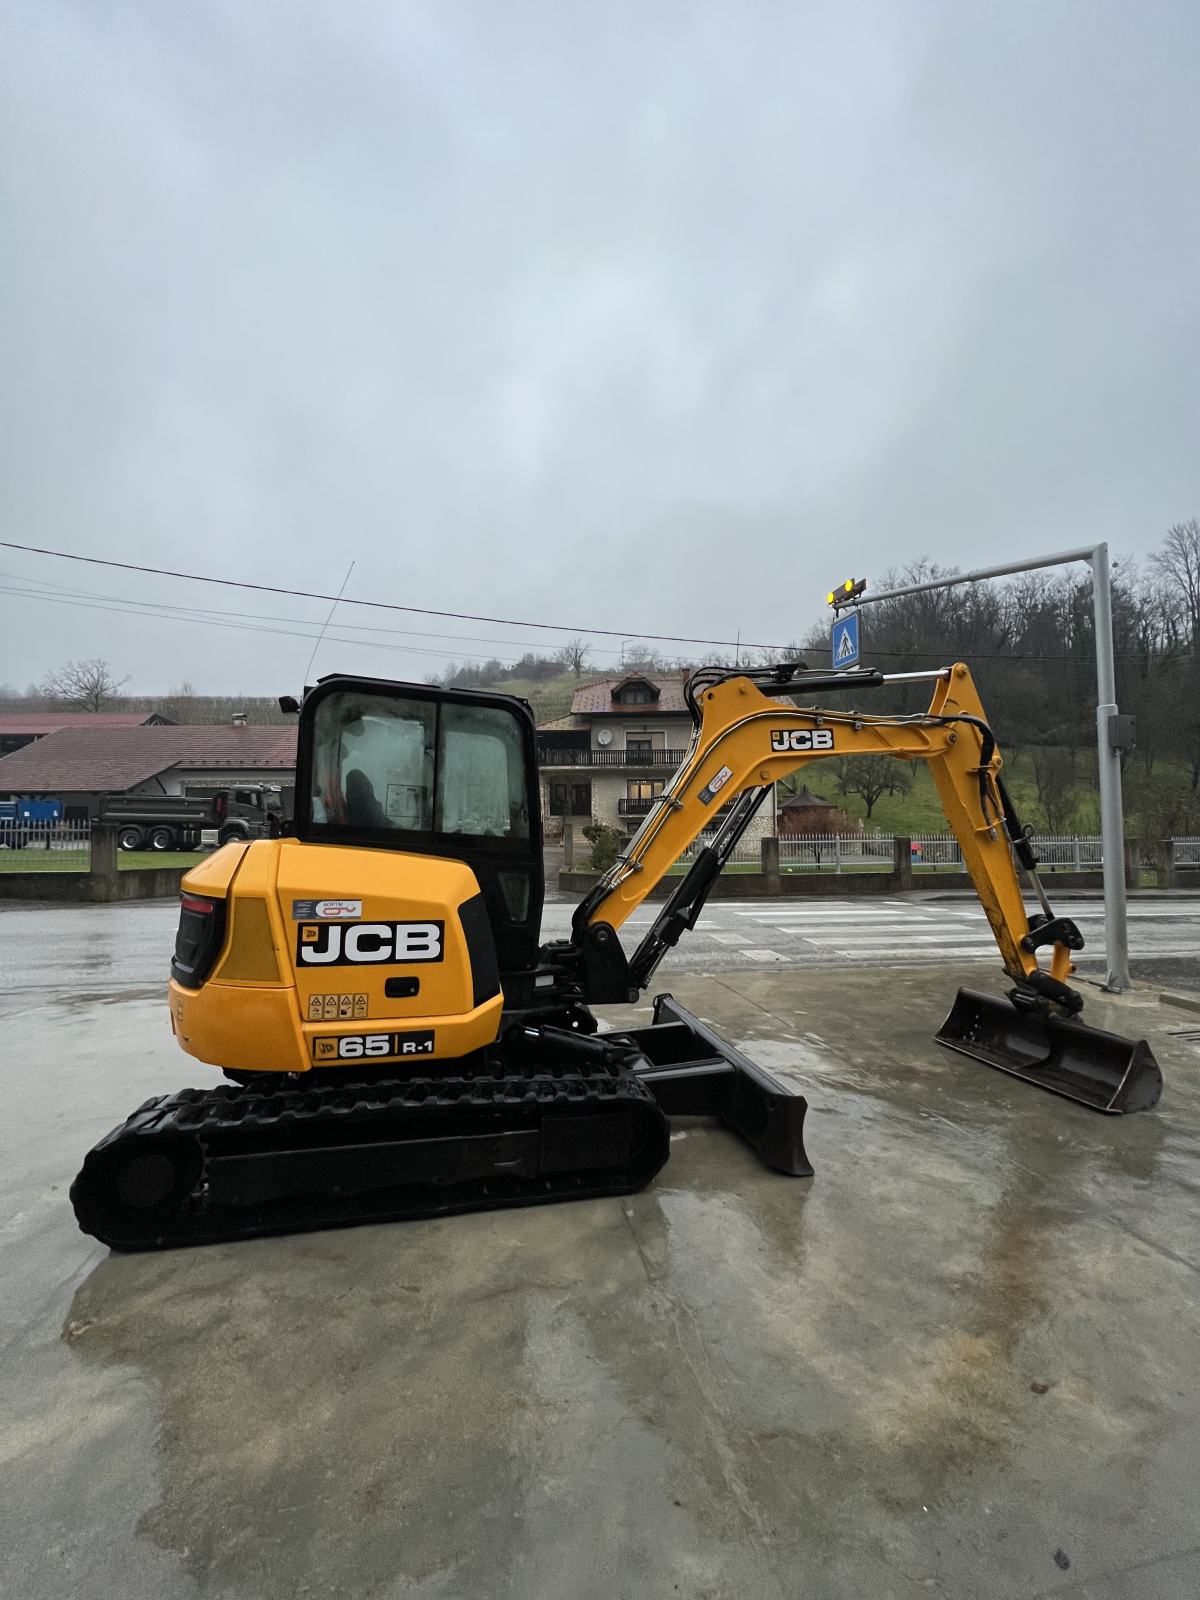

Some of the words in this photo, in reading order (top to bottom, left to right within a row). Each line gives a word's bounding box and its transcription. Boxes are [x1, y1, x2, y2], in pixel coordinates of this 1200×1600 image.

[773, 731, 832, 750] JCB
[302, 924, 441, 963] JCB
[339, 1035, 389, 1058] 65
[403, 1041, 432, 1053] R-1
